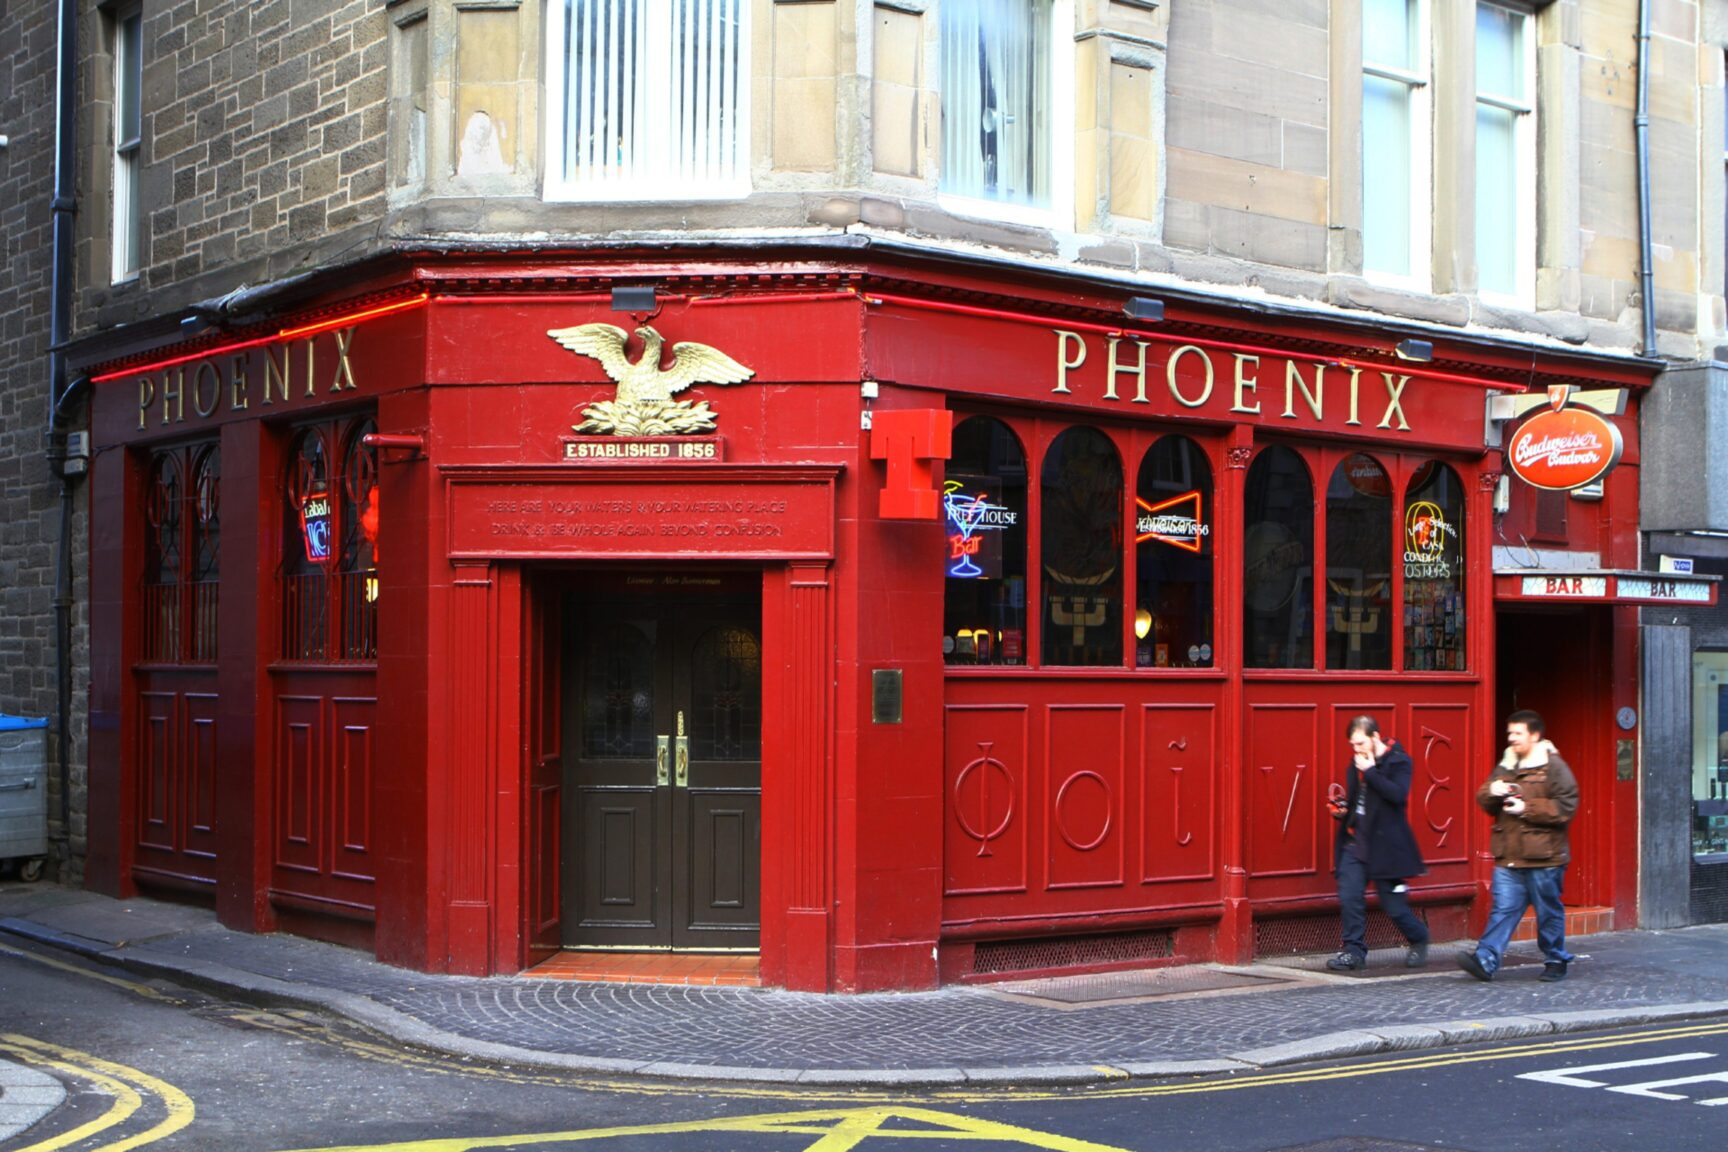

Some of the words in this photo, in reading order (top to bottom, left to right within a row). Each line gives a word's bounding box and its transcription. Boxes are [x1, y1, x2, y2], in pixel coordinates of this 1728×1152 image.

[136, 326, 358, 430] PHOENIX
[1051, 329, 1413, 432] PHOENIX
[566, 443, 671, 458] ESTABLISHED
[678, 443, 715, 458] 1856
[1515, 432, 1602, 464] Budweiser
[1547, 450, 1600, 468] Budvar
[487, 500, 517, 514] HERE
[520, 500, 542, 514] ARE
[548, 500, 582, 514] YOUR
[747, 500, 786, 514] PLACE
[660, 523, 708, 537] BEYOND
[713, 523, 784, 537] CONFUSION
[950, 535, 983, 559] Bar
[1545, 577, 1583, 594] BAR
[1651, 582, 1677, 598] BAR
